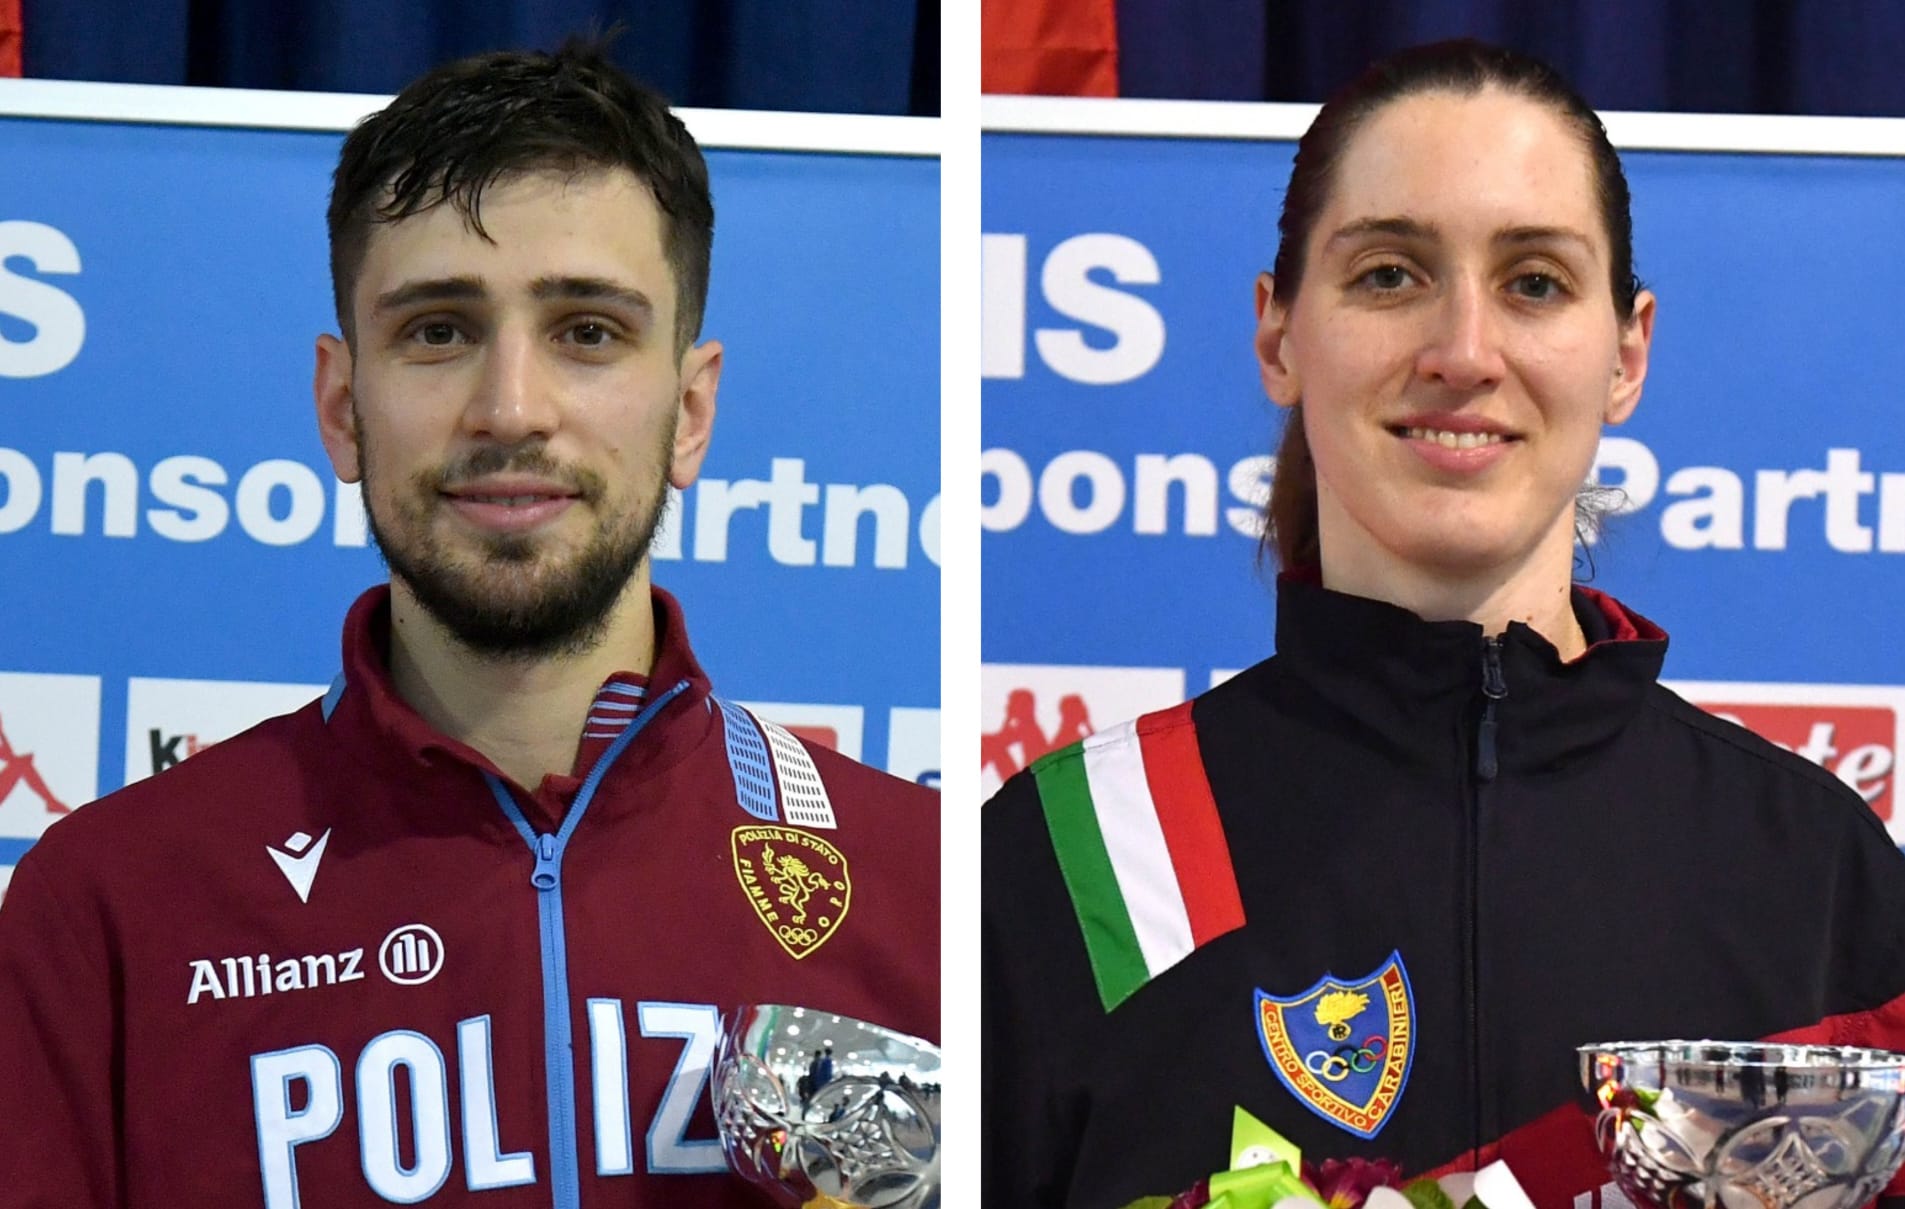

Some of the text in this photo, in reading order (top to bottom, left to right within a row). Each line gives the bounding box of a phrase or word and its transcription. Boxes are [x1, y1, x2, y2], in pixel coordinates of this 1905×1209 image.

[651, 457, 941, 569] rtn
[739, 829, 838, 865] POLIZIA DI STATO
[740, 858, 779, 923] FIAMME
[187, 948, 365, 1005] Allianz
[1264, 981, 1408, 1127] CENTRO SPORTIVO CARABINIERI
